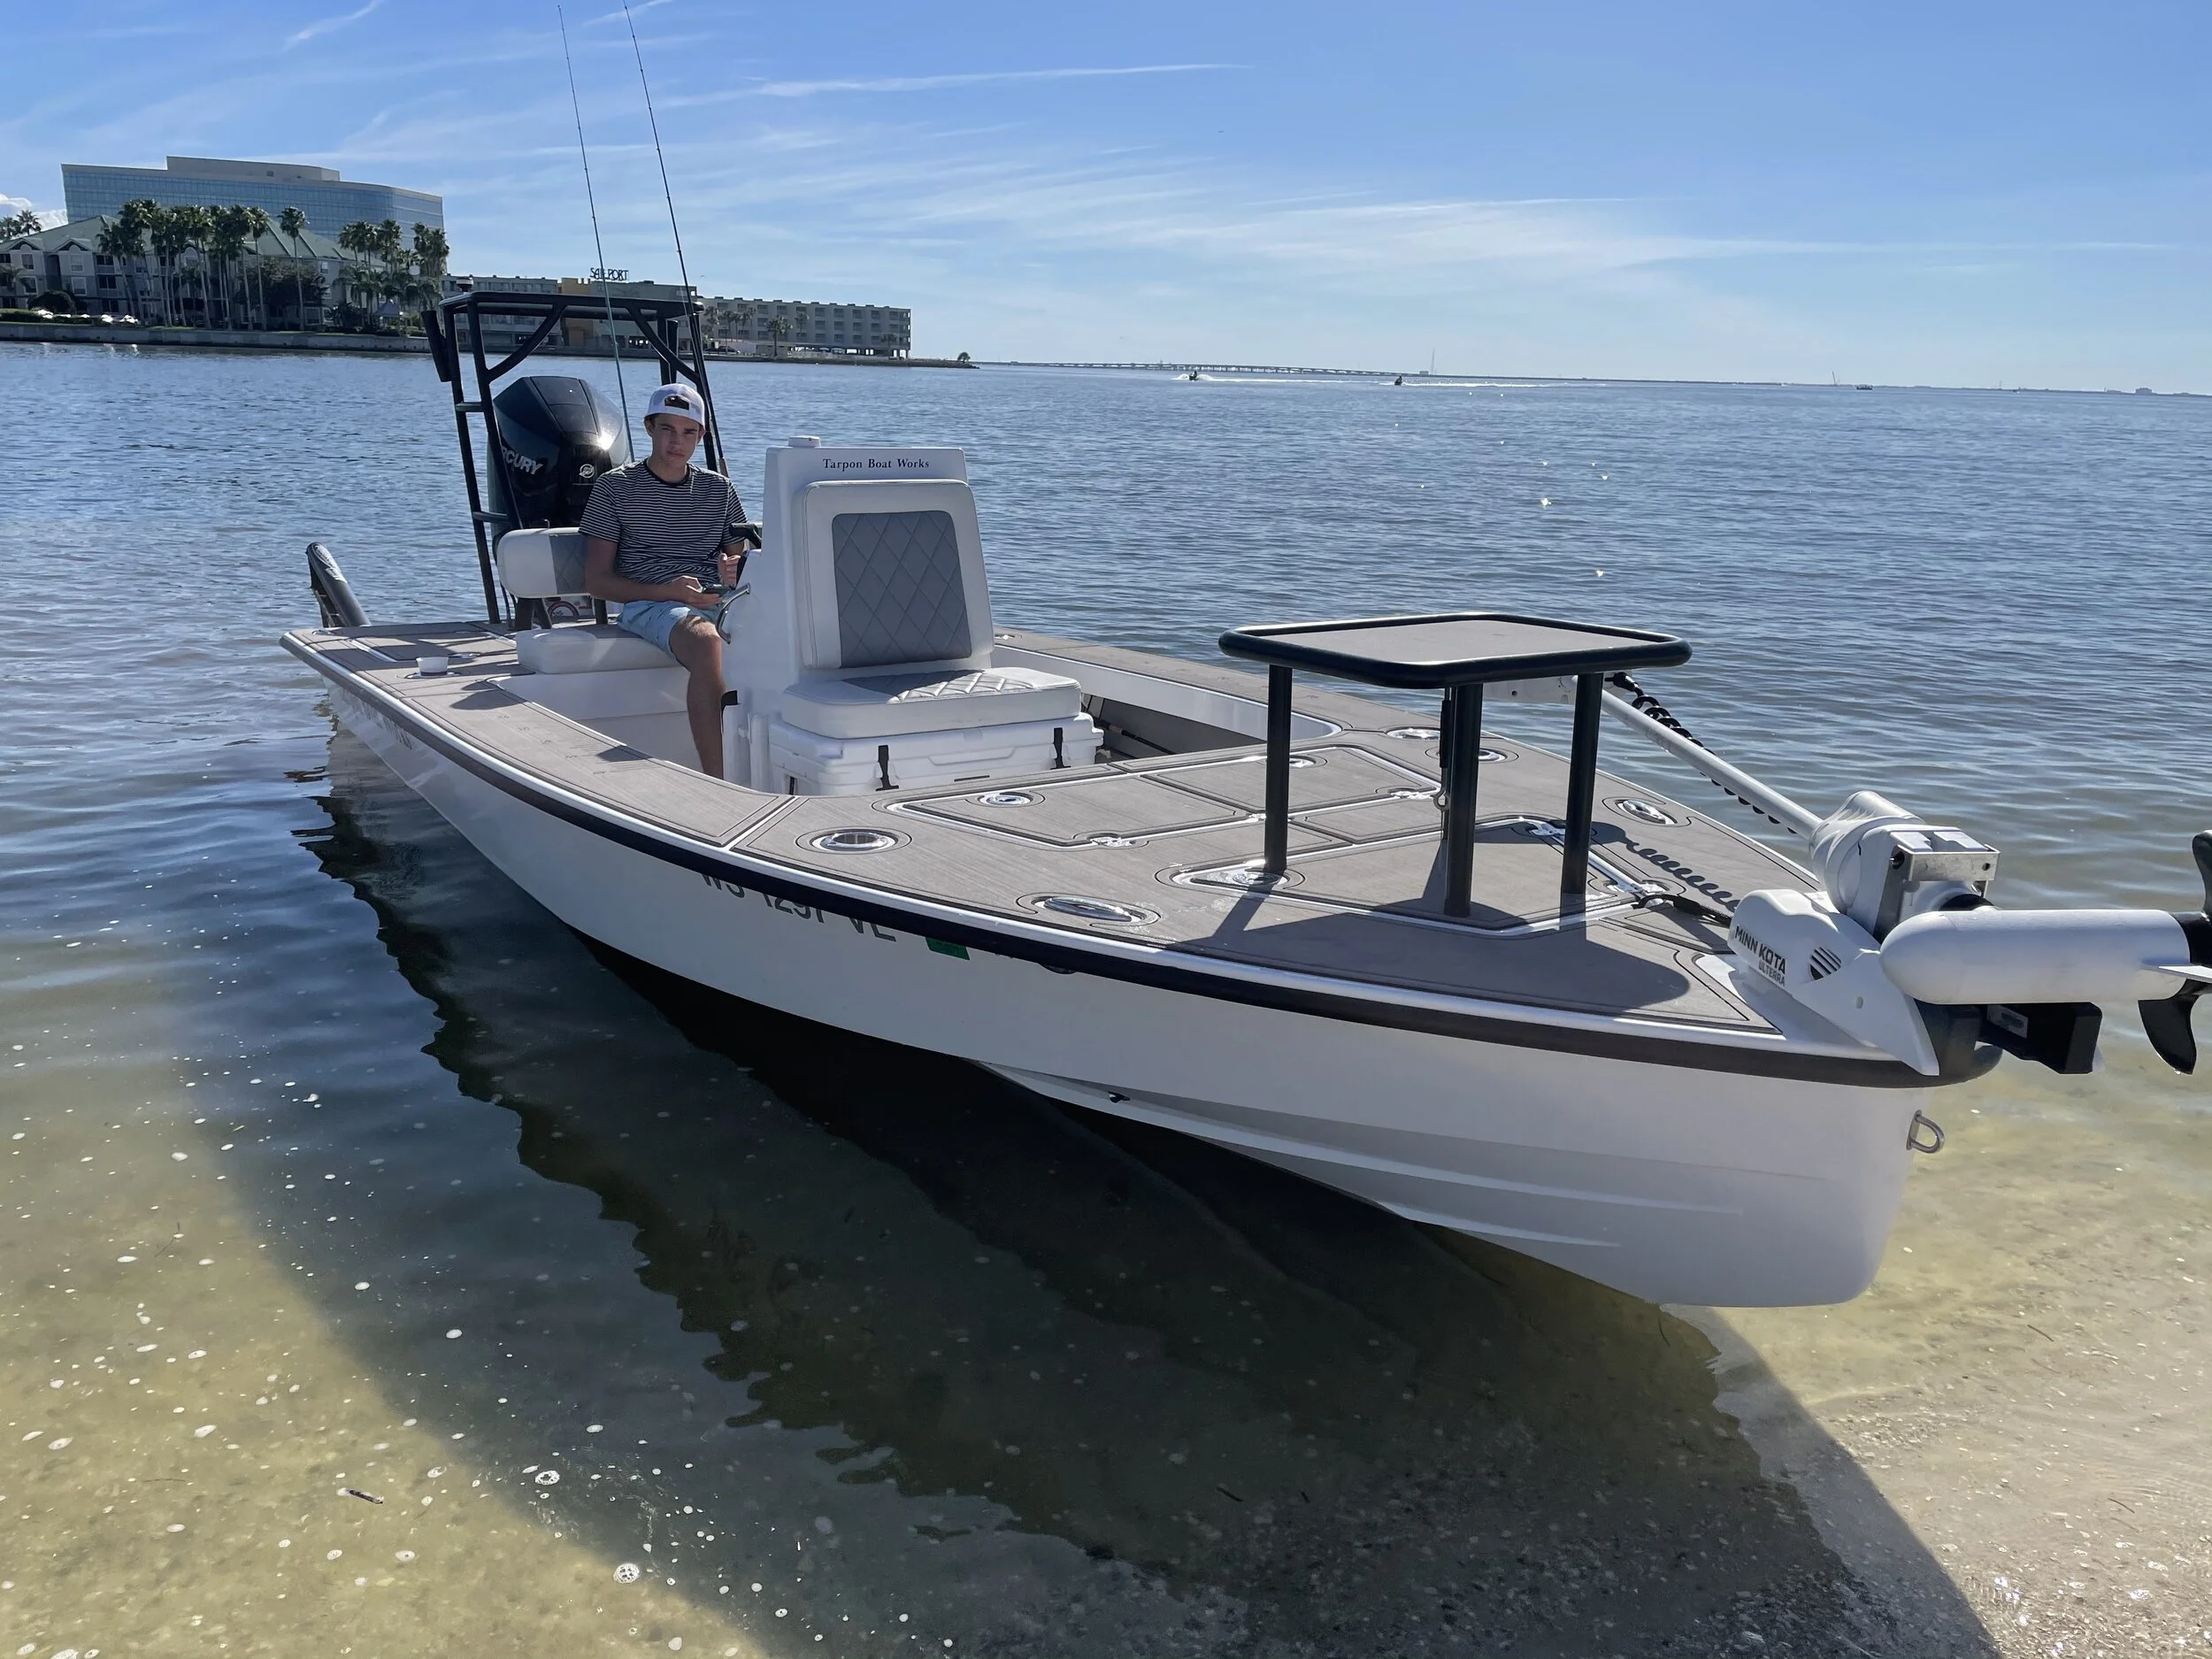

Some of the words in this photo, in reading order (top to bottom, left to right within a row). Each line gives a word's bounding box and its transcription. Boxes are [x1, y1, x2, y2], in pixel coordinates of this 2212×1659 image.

[501, 445, 544, 475] RCURY
[822, 458, 863, 472] Tarpon
[868, 458, 892, 469] Boat
[897, 458, 930, 469] Works
[1734, 926, 1759, 954] MINN
[1758, 943, 1786, 975] KOTA
[1758, 960, 1786, 987] ULTERRA
